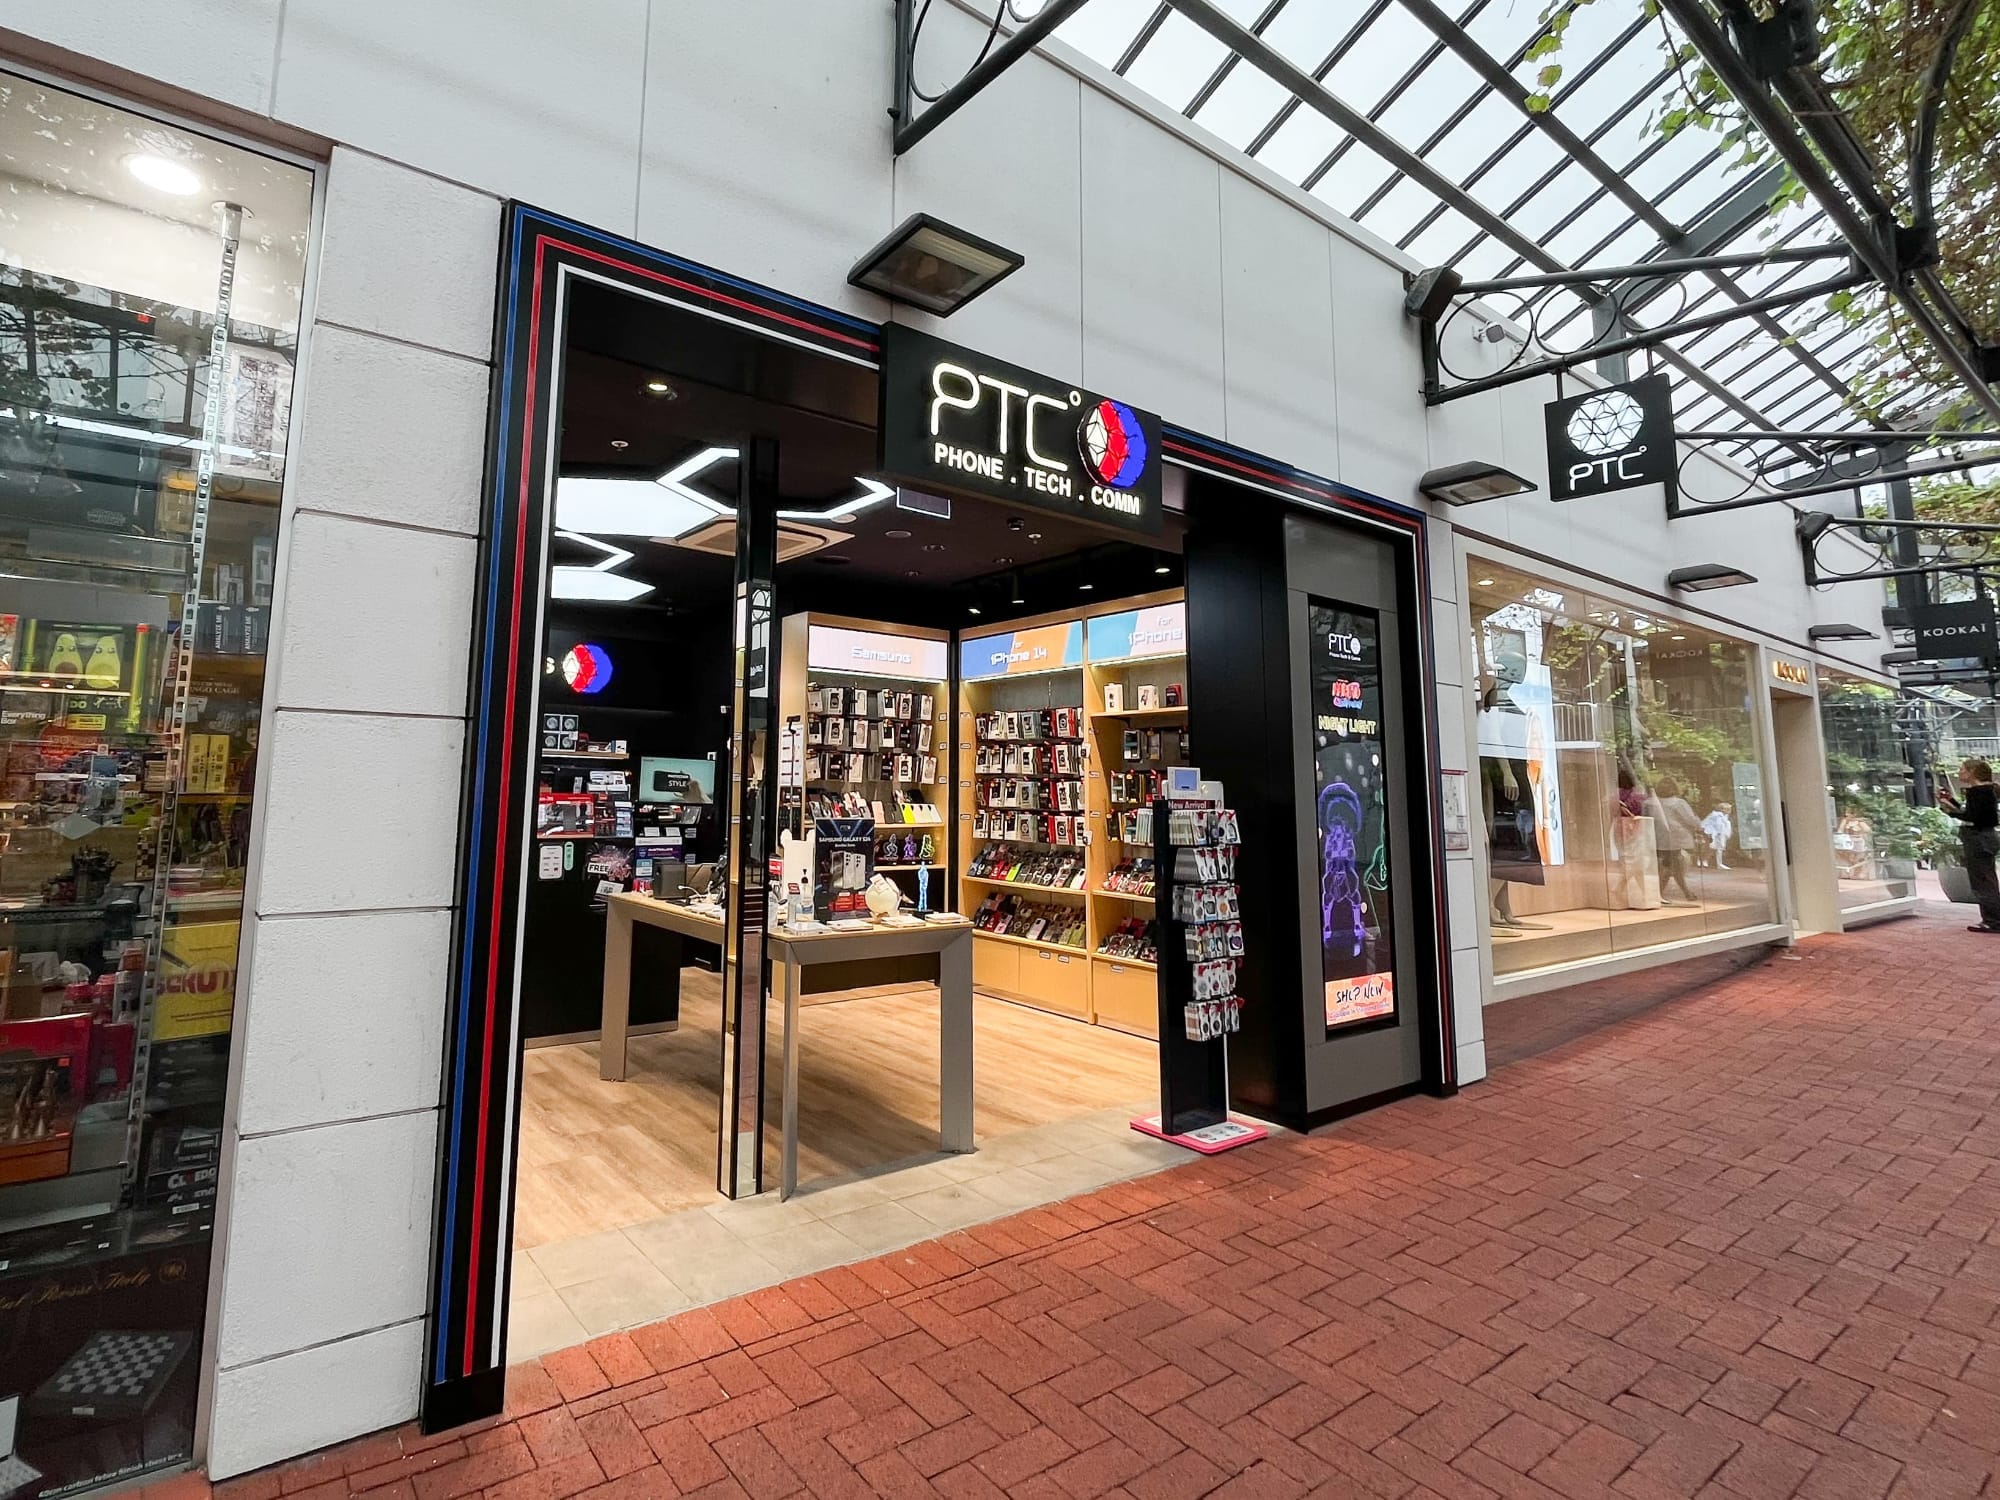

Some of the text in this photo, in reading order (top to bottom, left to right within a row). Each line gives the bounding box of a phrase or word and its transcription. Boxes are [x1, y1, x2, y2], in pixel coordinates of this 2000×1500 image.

[934, 442, 1004, 480] PHONE
[1024, 467, 1072, 498] TECH
[1091, 486, 1140, 516] COMM
[1158, 616, 1173, 626] for
[1128, 629, 1184, 646] iPhone
[990, 646, 1047, 666] iPhone 14
[1, 710, 46, 719] Everything
[1318, 714, 1377, 735] NIGHT LIGHT
[1168, 800, 1207, 810] New Arrival
[589, 864, 609, 872] FREE
